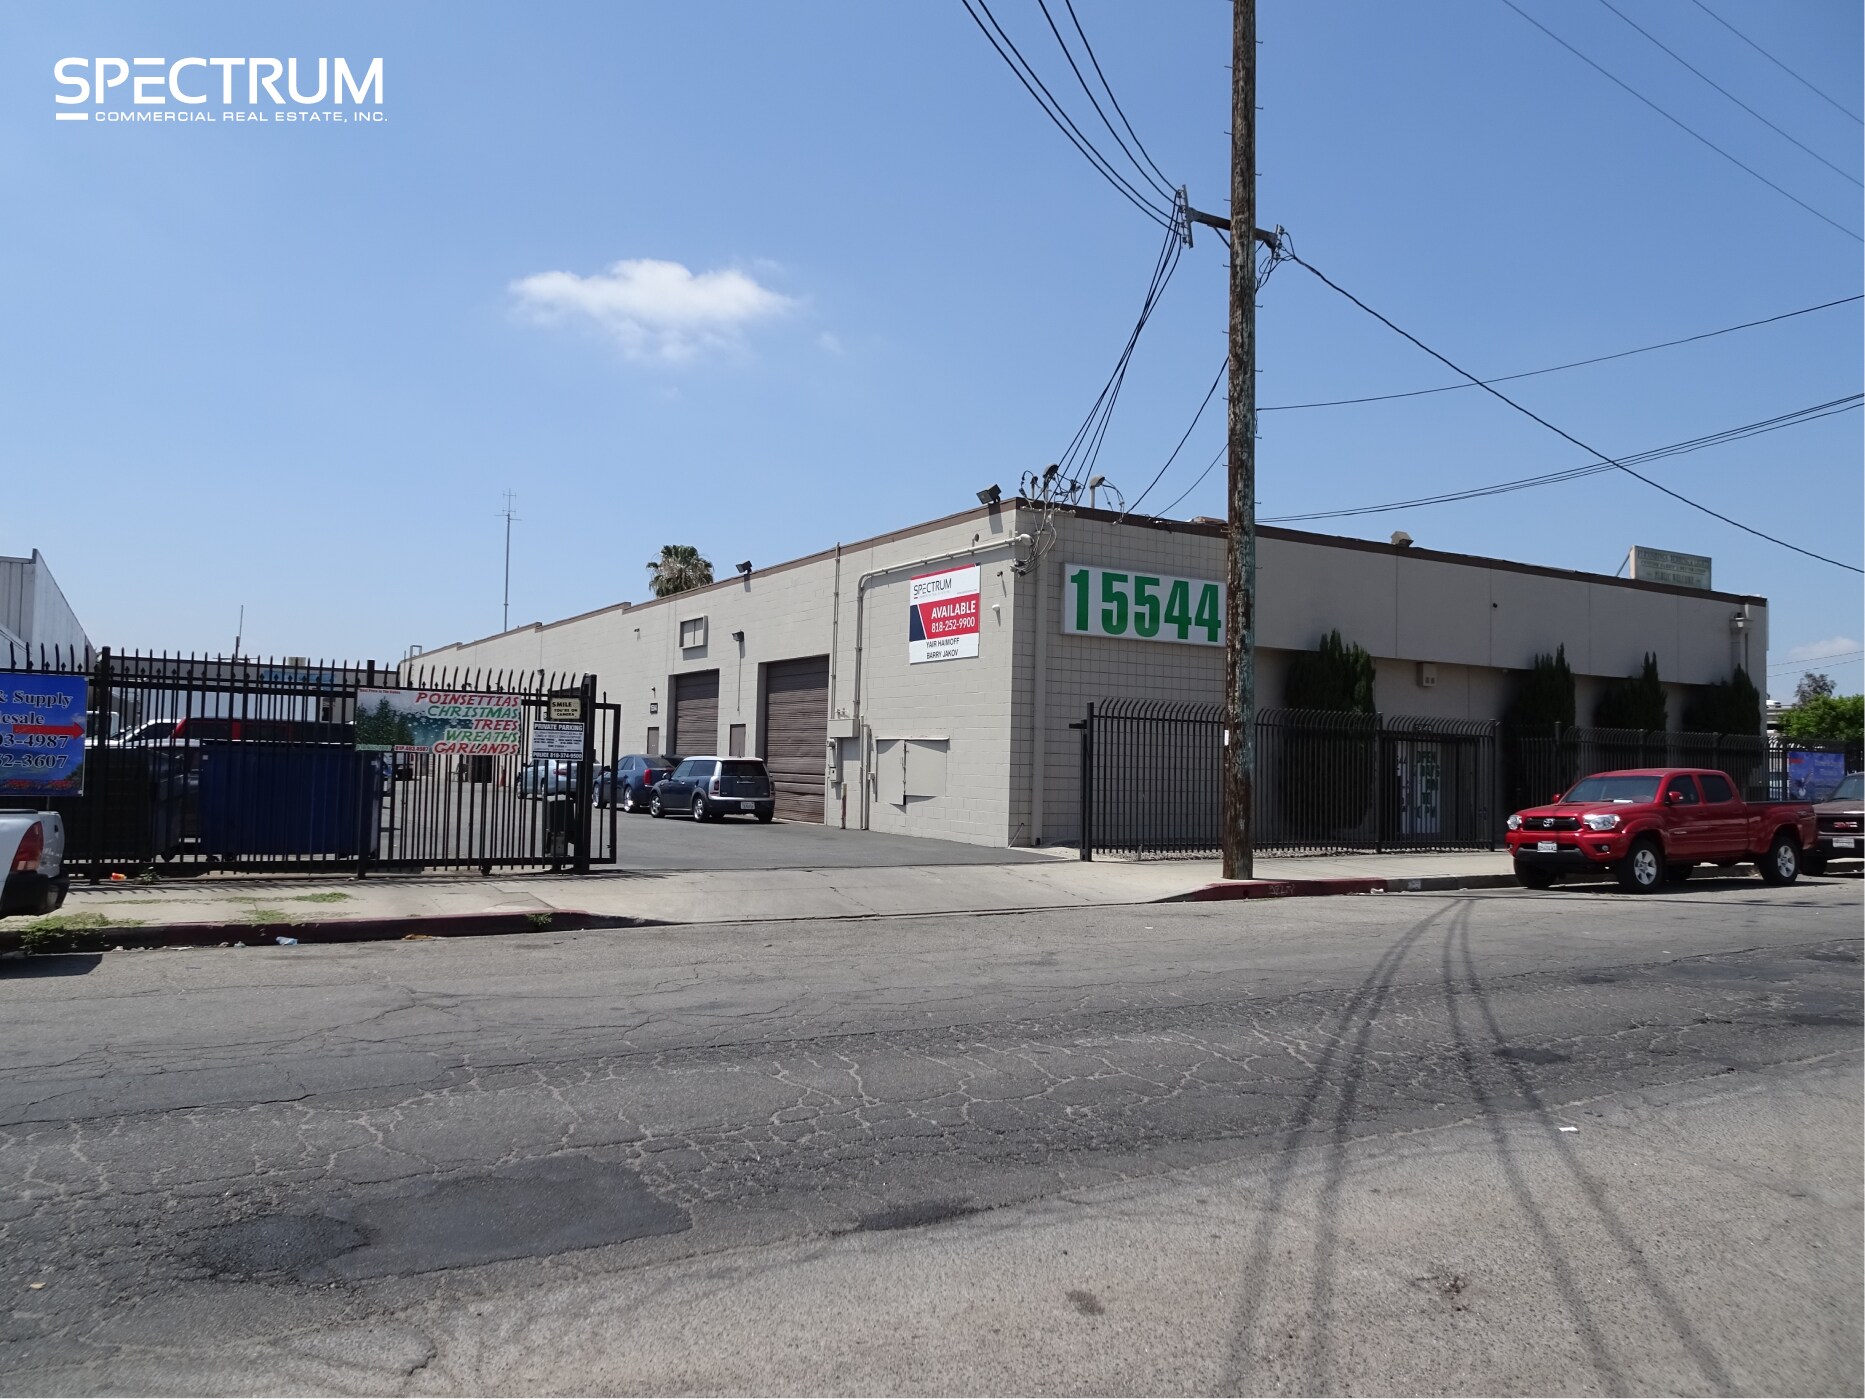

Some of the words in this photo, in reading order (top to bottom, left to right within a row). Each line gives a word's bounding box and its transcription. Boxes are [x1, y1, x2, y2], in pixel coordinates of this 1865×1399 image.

[913, 578, 952, 596] SPECTRUM
[931, 600, 976, 619] AVAILABLE
[1071, 569, 1222, 643] 15544
[931, 616, 975, 633] 818-252-9900
[926, 640, 937, 649] YAIR
[926, 650, 942, 660] BARRY
[942, 649, 959, 658] JAKOV
[12, 690, 73, 708] Supply
[415, 692, 519, 707] POINSETTIAS
[0, 711, 45, 725] esale
[427, 705, 519, 718] CHRISTMAS
[473, 719, 518, 731] TREES
[446, 730, 518, 743] WREATHS
[434, 742, 518, 755] GARLANDS
